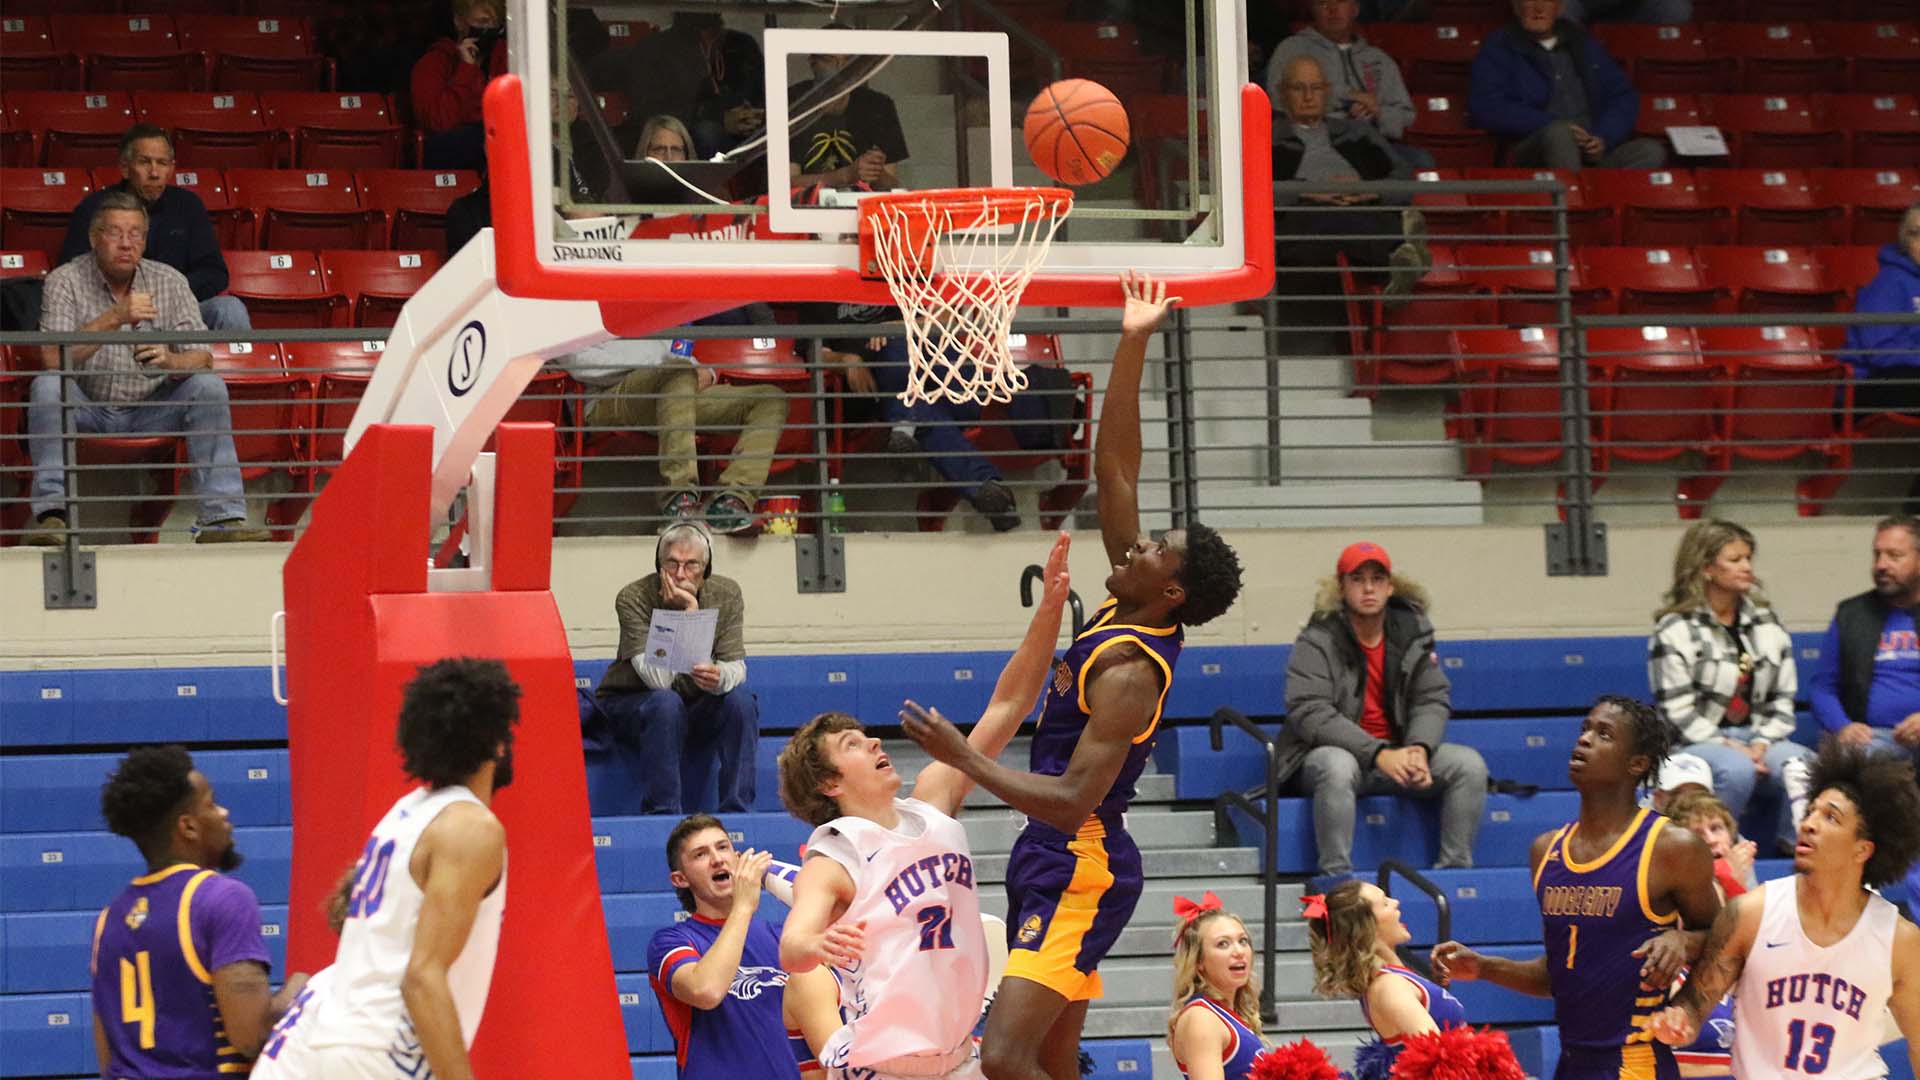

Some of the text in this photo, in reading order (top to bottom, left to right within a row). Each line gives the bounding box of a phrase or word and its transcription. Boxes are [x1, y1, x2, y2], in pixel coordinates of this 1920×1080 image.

[277, 256, 286, 268] 6
[406, 256, 414, 267] 7
[553, 245, 623, 261] SPALDING
[884, 852, 973, 916] HUTCH
[1567, 924, 1578, 969] 1
[120, 951, 155, 1049] 4
[1766, 972, 1867, 1021] HUTCH
[1784, 1018, 1836, 1075] 13
